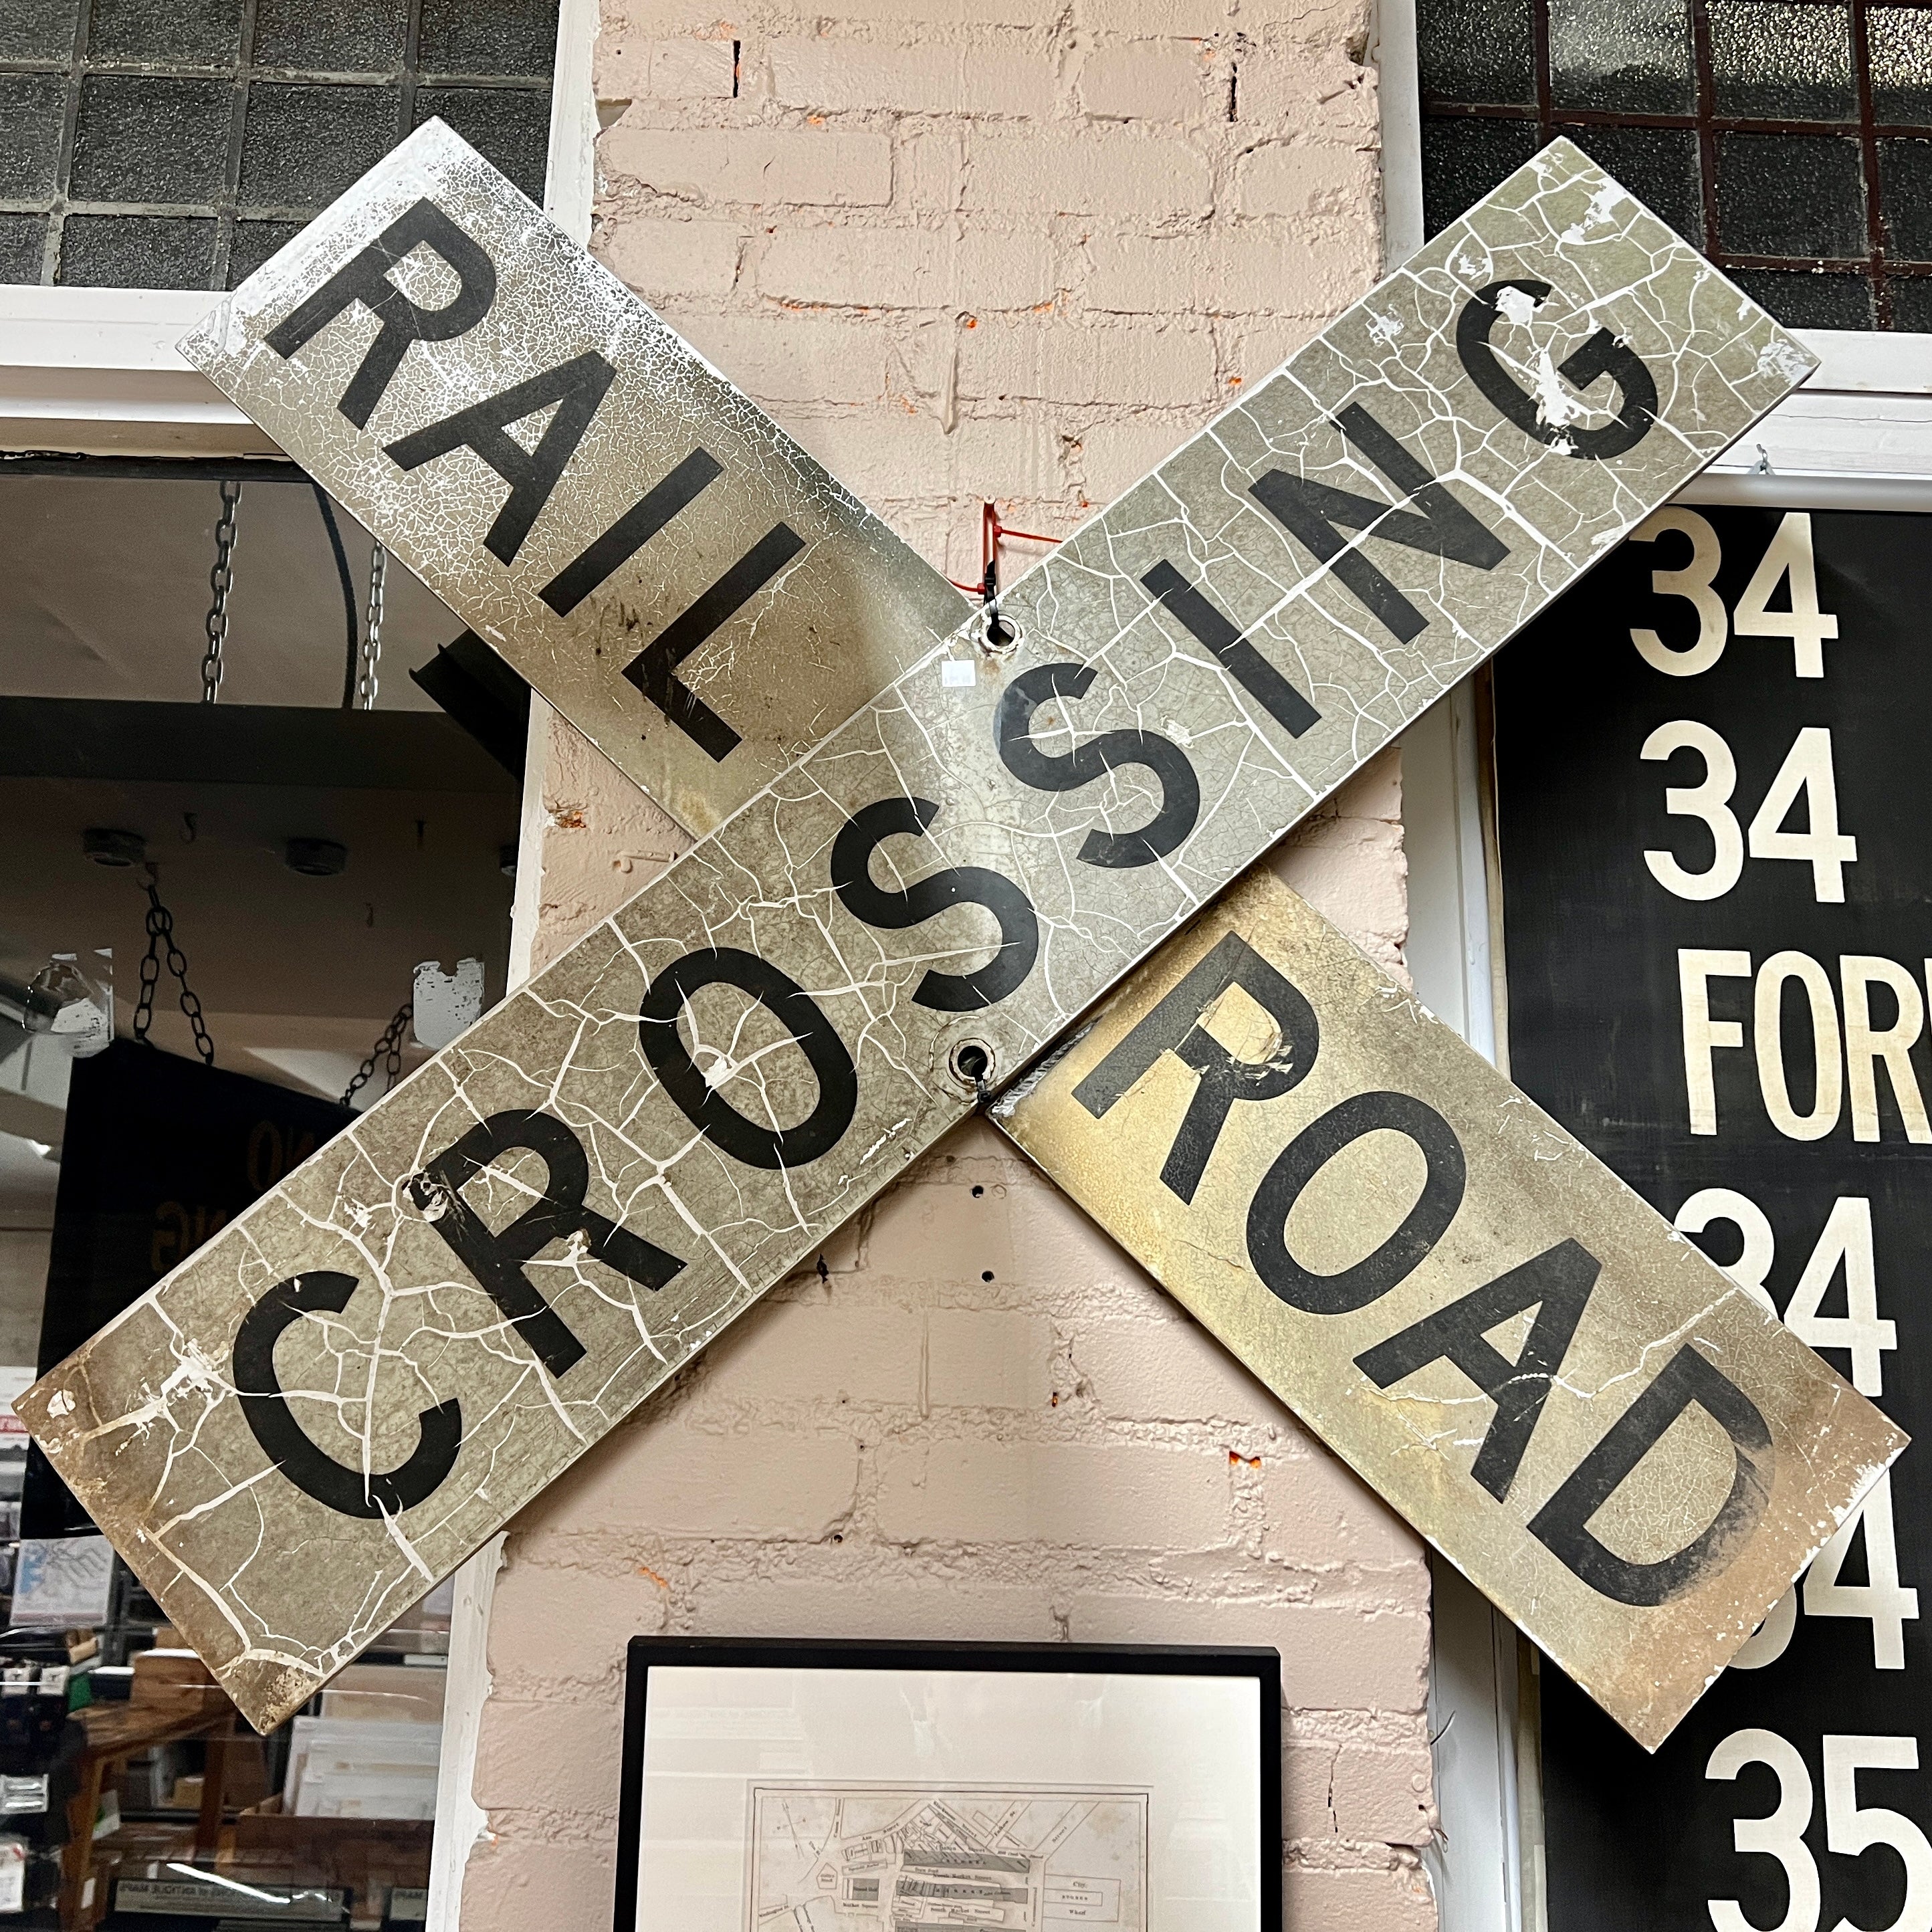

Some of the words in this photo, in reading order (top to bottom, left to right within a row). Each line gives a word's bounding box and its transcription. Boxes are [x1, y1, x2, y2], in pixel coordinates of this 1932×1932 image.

[1628, 506, 1838, 678] 34
[231, 280, 1660, 1519] CROSSING
[267, 200, 805, 761] RAIL
[1073, 931, 1775, 1607] ROAD
[1640, 720, 1857, 903] 34
[1678, 948, 1932, 1145] FOR
[1705, 1729, 1932, 1932] 35
